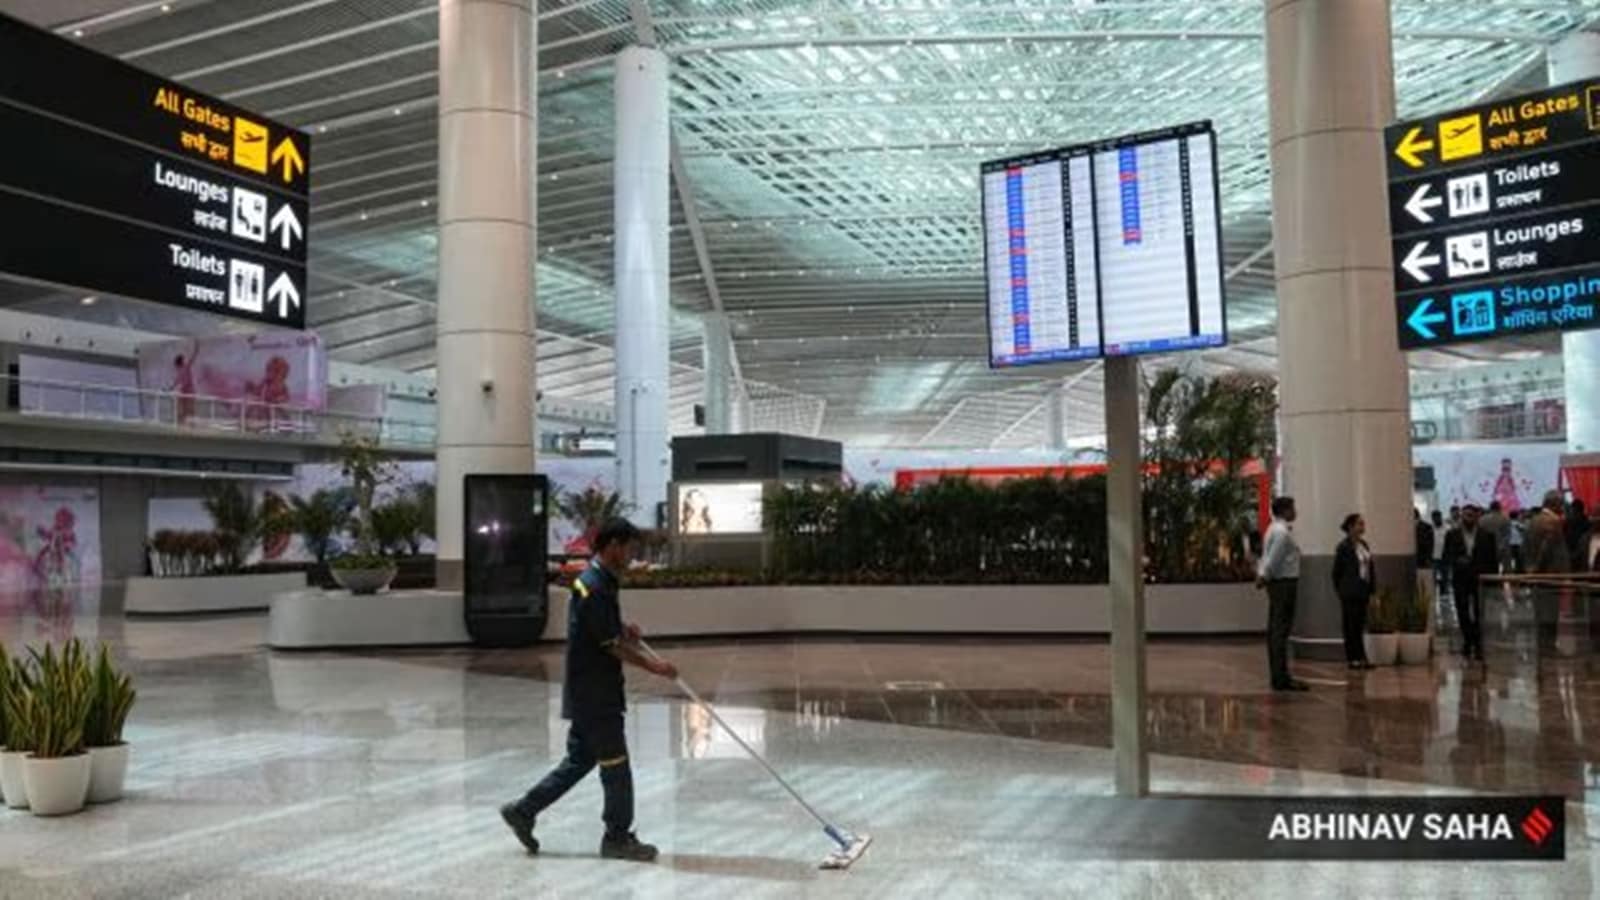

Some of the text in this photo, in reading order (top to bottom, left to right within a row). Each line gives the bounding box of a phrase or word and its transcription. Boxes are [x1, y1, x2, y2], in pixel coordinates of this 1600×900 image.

[154, 87, 231, 132] All Gates
[1488, 94, 1580, 127] All Gates
[154, 161, 229, 203] Lounges
[1495, 160, 1561, 185] Toilets
[1494, 218, 1584, 245] Lounges
[169, 243, 226, 275] Toilets
[1501, 276, 1600, 306] Shoppin
